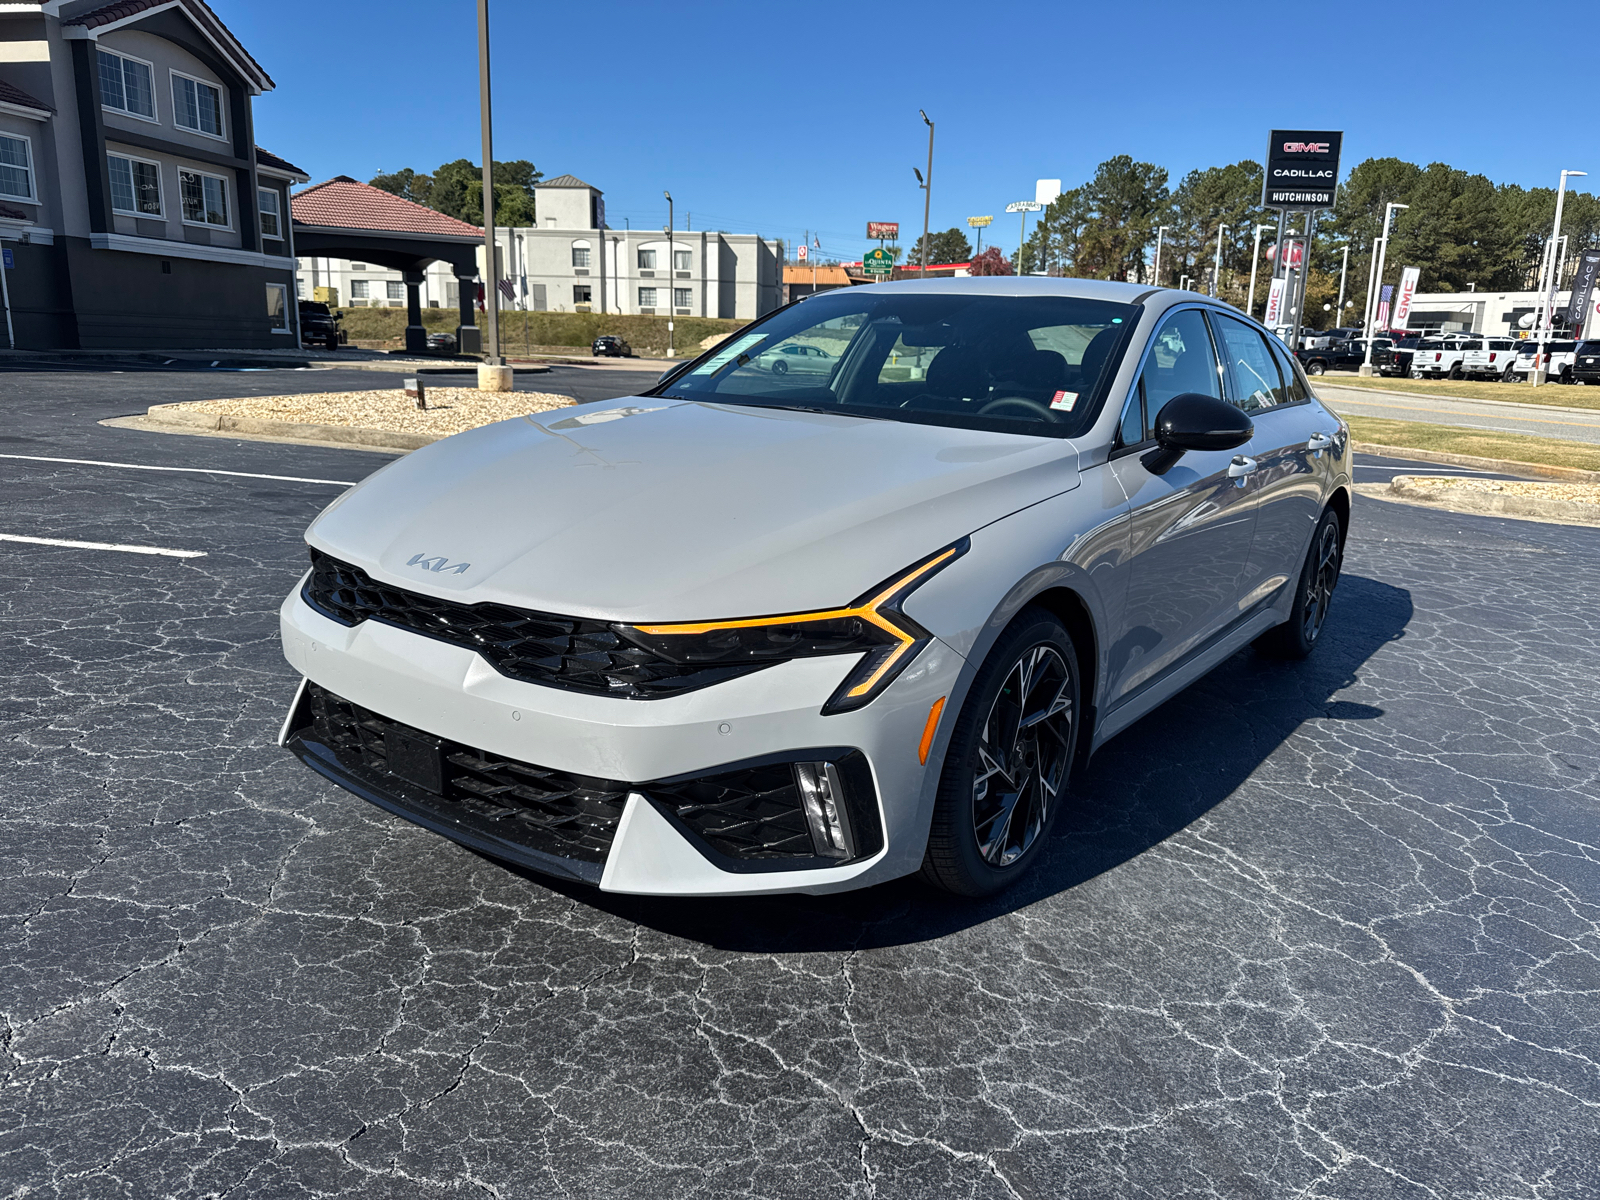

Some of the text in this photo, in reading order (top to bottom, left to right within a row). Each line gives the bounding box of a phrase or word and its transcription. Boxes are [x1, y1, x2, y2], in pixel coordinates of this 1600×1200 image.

[1283, 142, 1330, 153] GMC
[1273, 169, 1333, 178] CADILLAC
[1272, 192, 1329, 203] HUTCHINSON
[1398, 280, 1414, 319] GMC
[1575, 265, 1594, 320] CADILLAC
[1269, 289, 1280, 320] GMC
[406, 553, 471, 575] KIA
